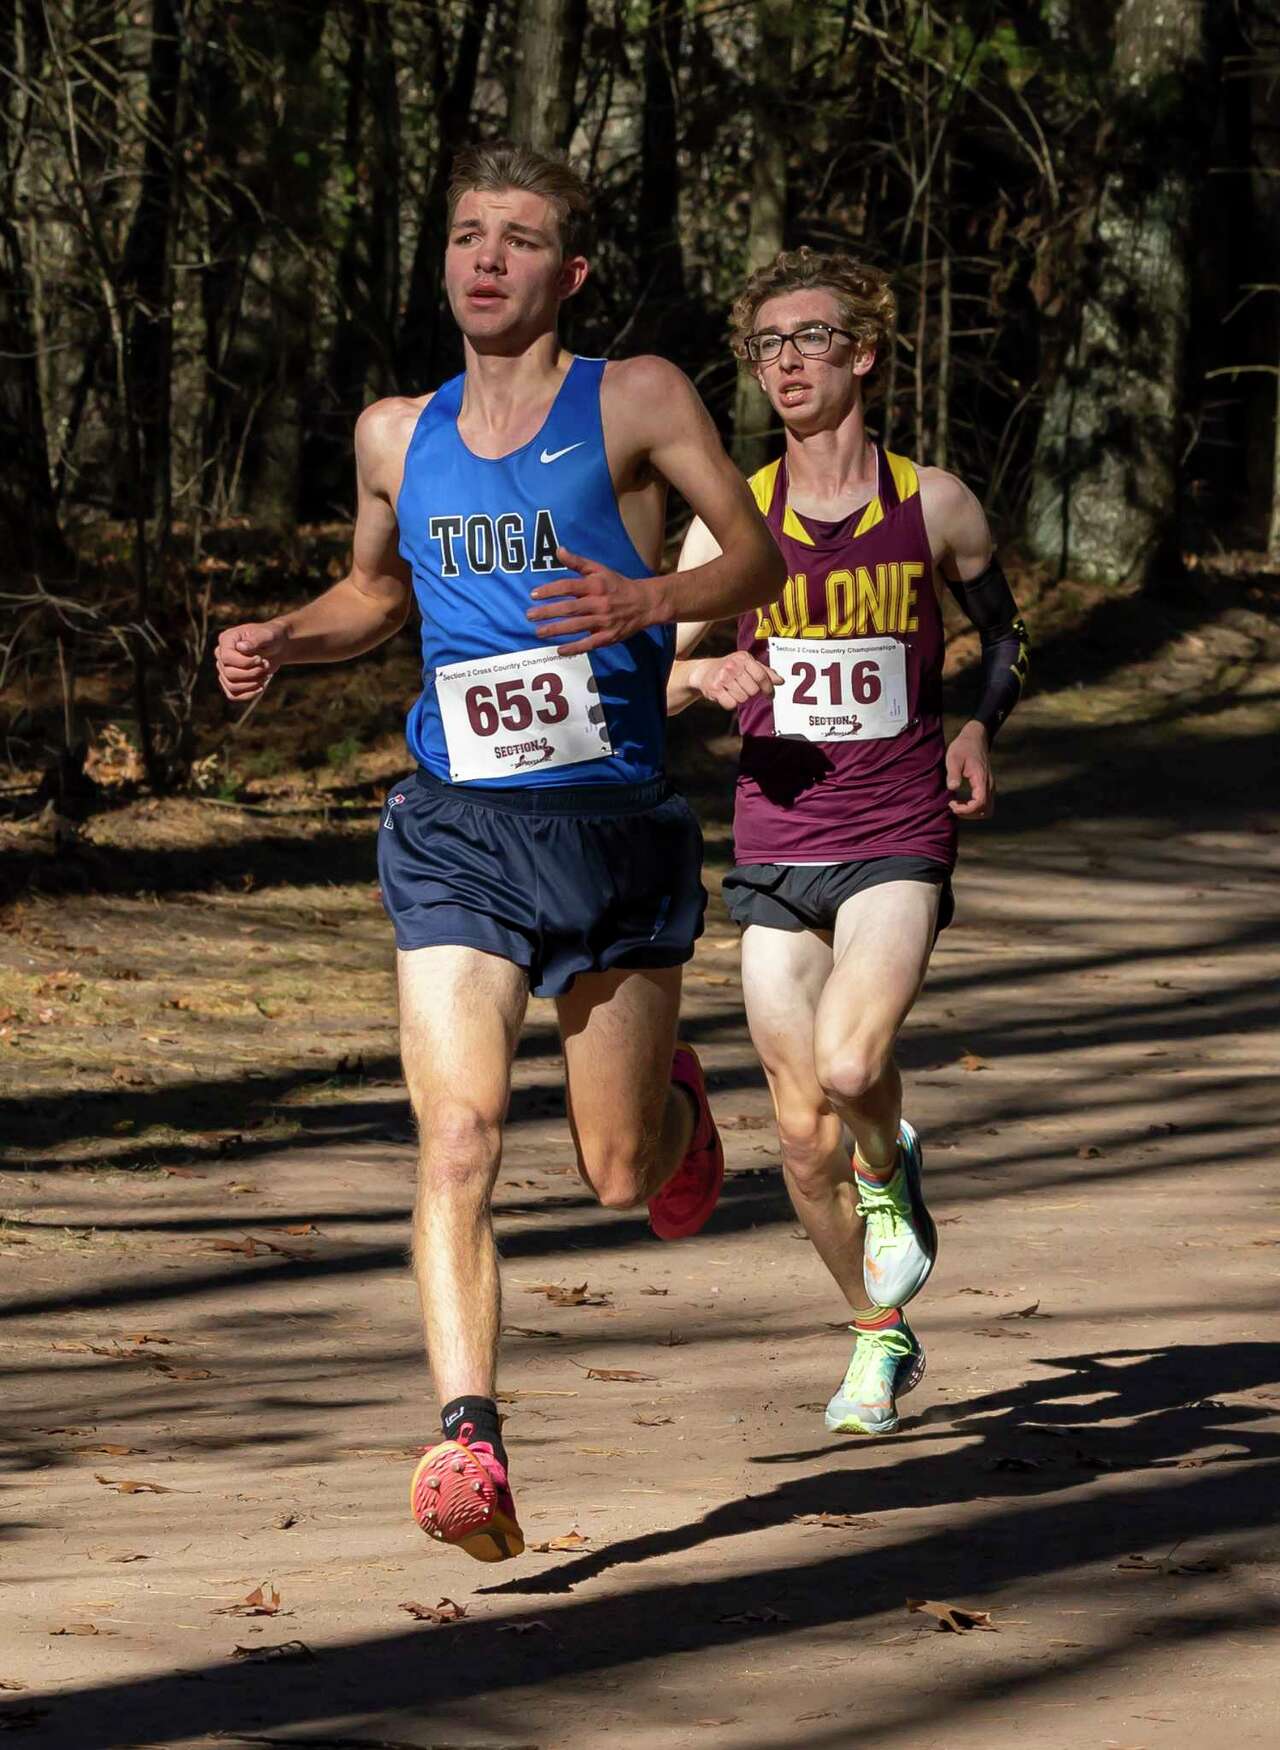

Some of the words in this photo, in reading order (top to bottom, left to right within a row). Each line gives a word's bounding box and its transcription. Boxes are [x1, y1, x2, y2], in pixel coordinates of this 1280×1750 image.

[429, 509, 568, 577] TOGA
[443, 671, 467, 681] Section
[472, 667, 492, 676] Cross
[493, 662, 521, 674] Country
[820, 647, 846, 655] Country
[465, 672, 570, 737] 653
[791, 660, 882, 706] 216
